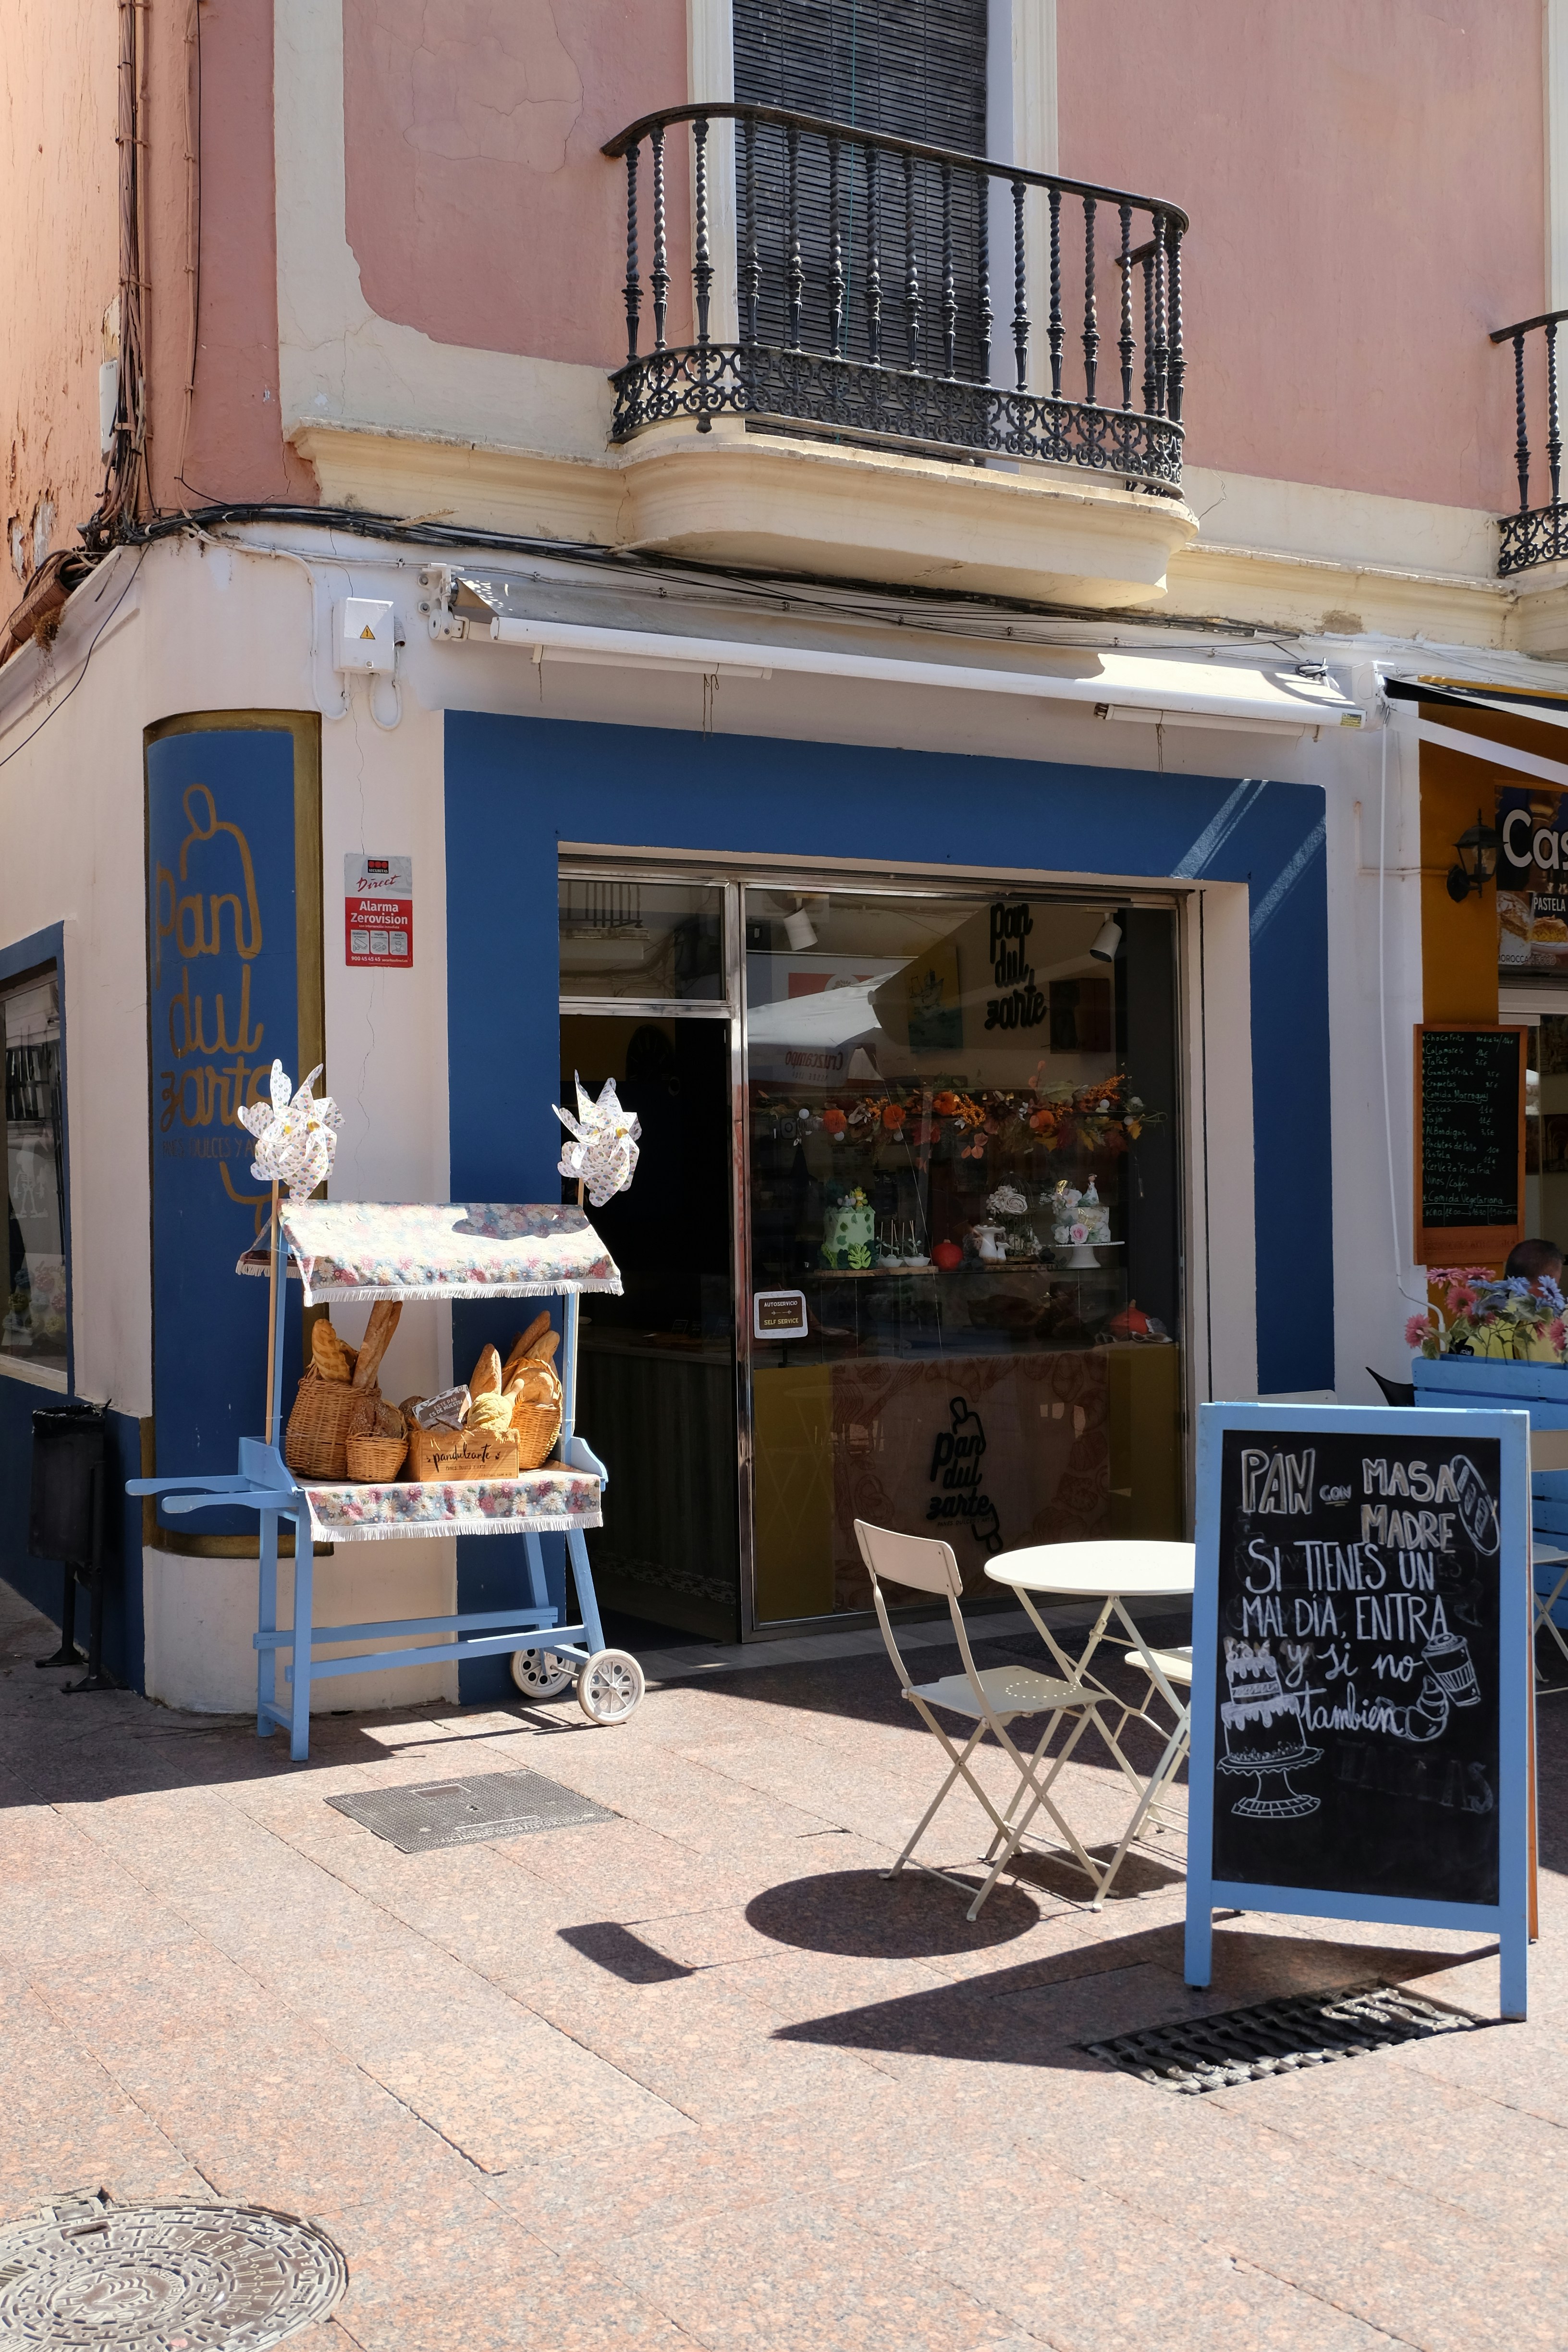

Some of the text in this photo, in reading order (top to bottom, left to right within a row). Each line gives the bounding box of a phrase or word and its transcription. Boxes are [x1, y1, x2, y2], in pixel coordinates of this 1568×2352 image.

[356, 875, 402, 892] Direct
[359, 901, 399, 912] Alarma
[1534, 897, 1566, 912] PASTELA
[351, 913, 407, 924] Zerovision
[433, 1401, 446, 1410] ESTE
[444, 1399, 464, 1410] MUESTRA
[432, 1441, 492, 1473] pandulzarte
[1241, 1448, 1460, 1515] PAN CON MASA
[1360, 1504, 1457, 1553] MADRE
[1245, 1538, 1282, 1594] SI
[1293, 1540, 1387, 1592] TIENES
[1399, 1551, 1434, 1592] UN
[1242, 1594, 1287, 1638] MAL
[1356, 1592, 1448, 1642] ENTRA
[1286, 1642, 1423, 1687] y si no
